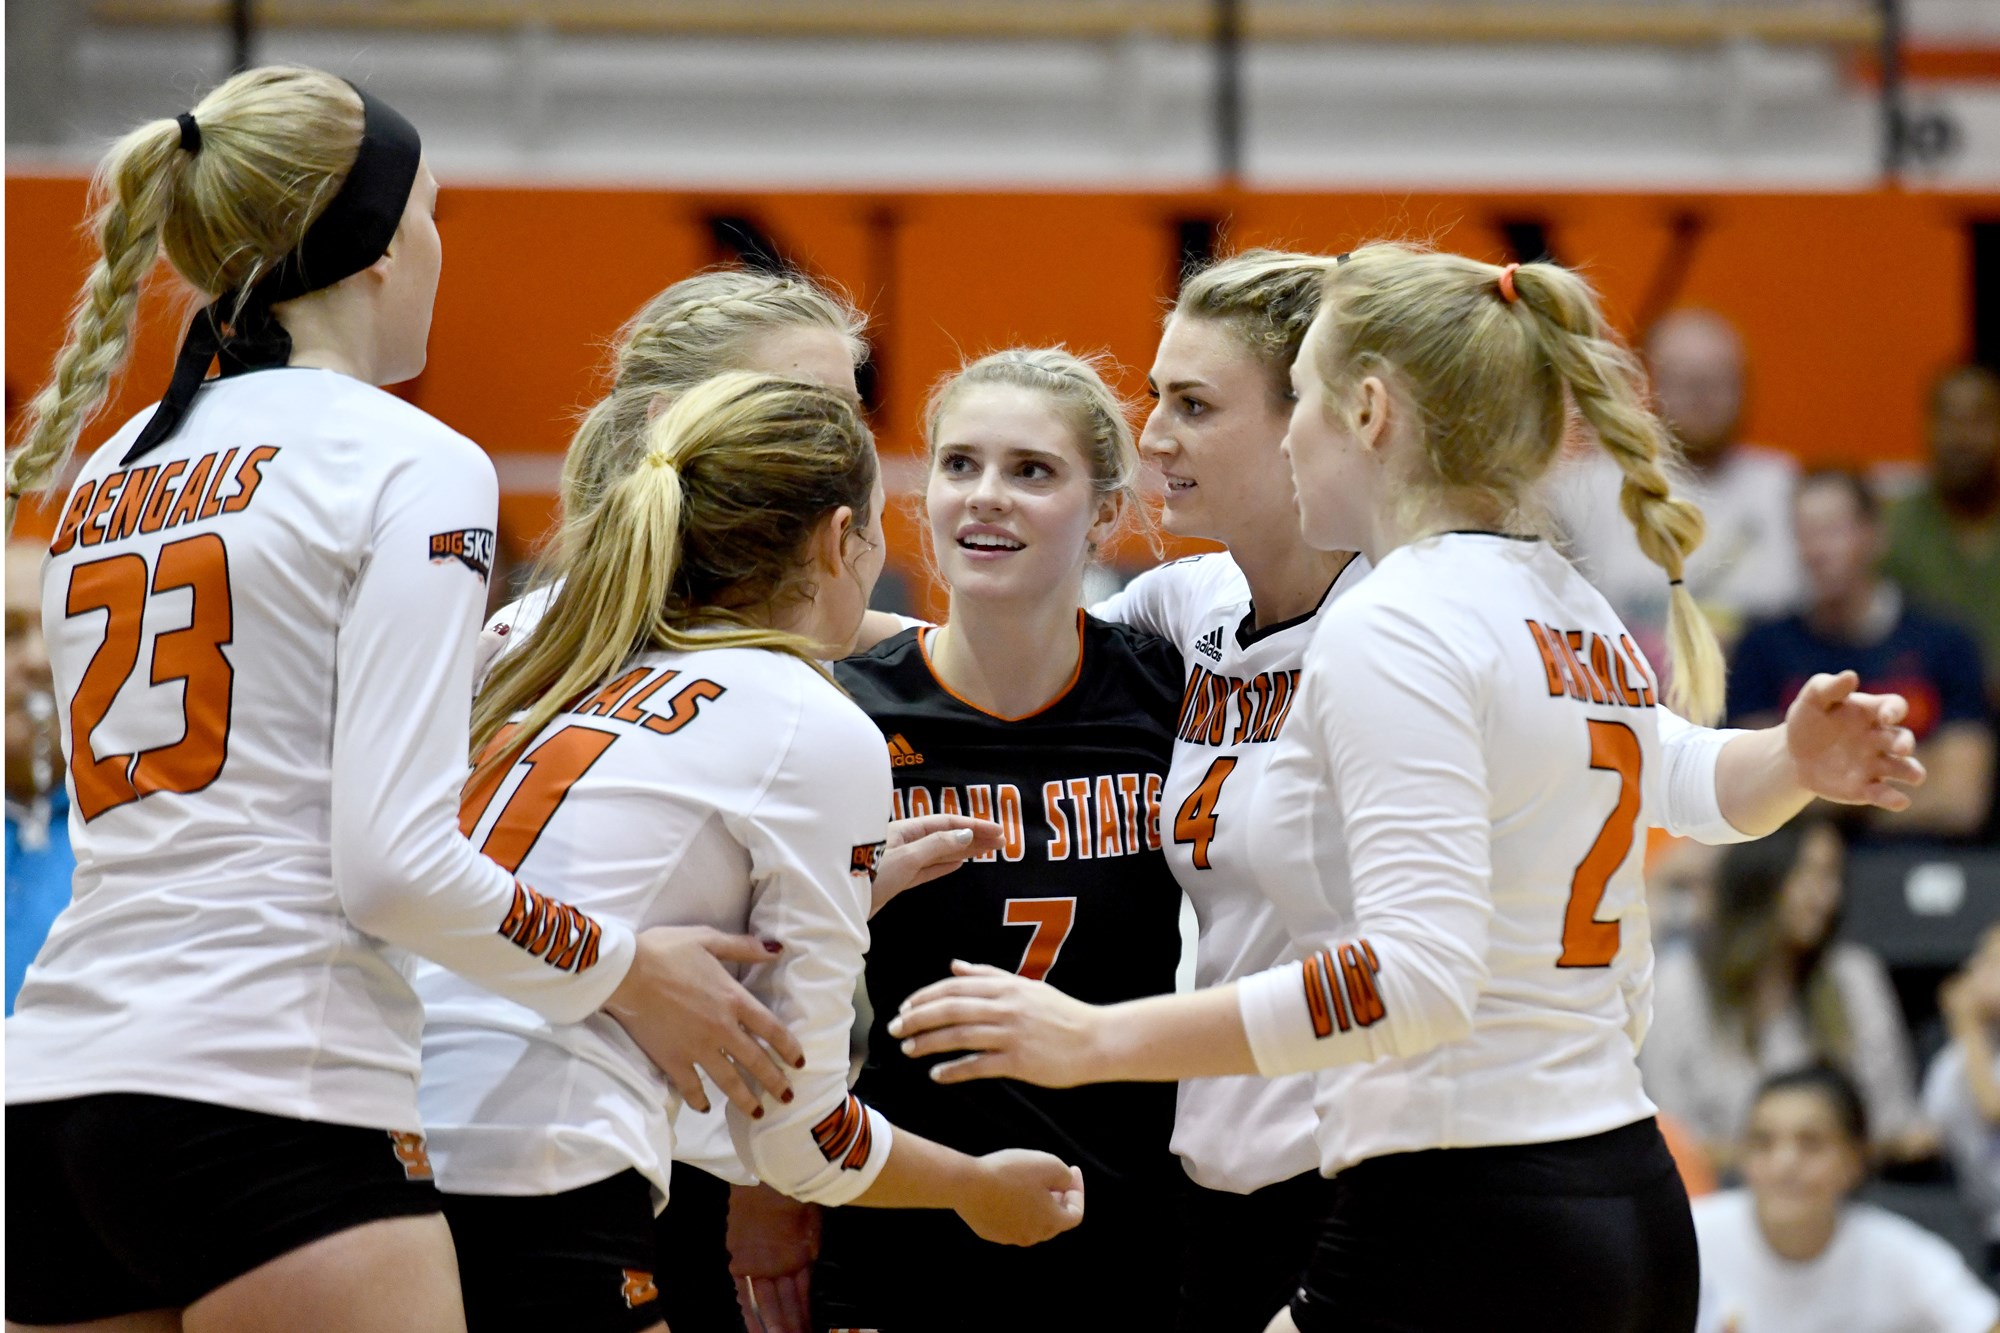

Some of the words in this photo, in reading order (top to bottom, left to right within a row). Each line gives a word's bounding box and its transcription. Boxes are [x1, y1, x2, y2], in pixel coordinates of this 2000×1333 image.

[50, 445, 282, 557] BENGALS
[65, 532, 234, 825] 23
[1195, 639, 1223, 662] adidas
[572, 666, 728, 735] ALS
[1231, 669, 1303, 747] STAT
[458, 721, 621, 876] 11
[891, 752, 925, 768] idas
[1043, 773, 1162, 861] STATE
[1174, 756, 1239, 871] 4
[1554, 717, 1644, 969] 2
[1002, 896, 1078, 981] 7
